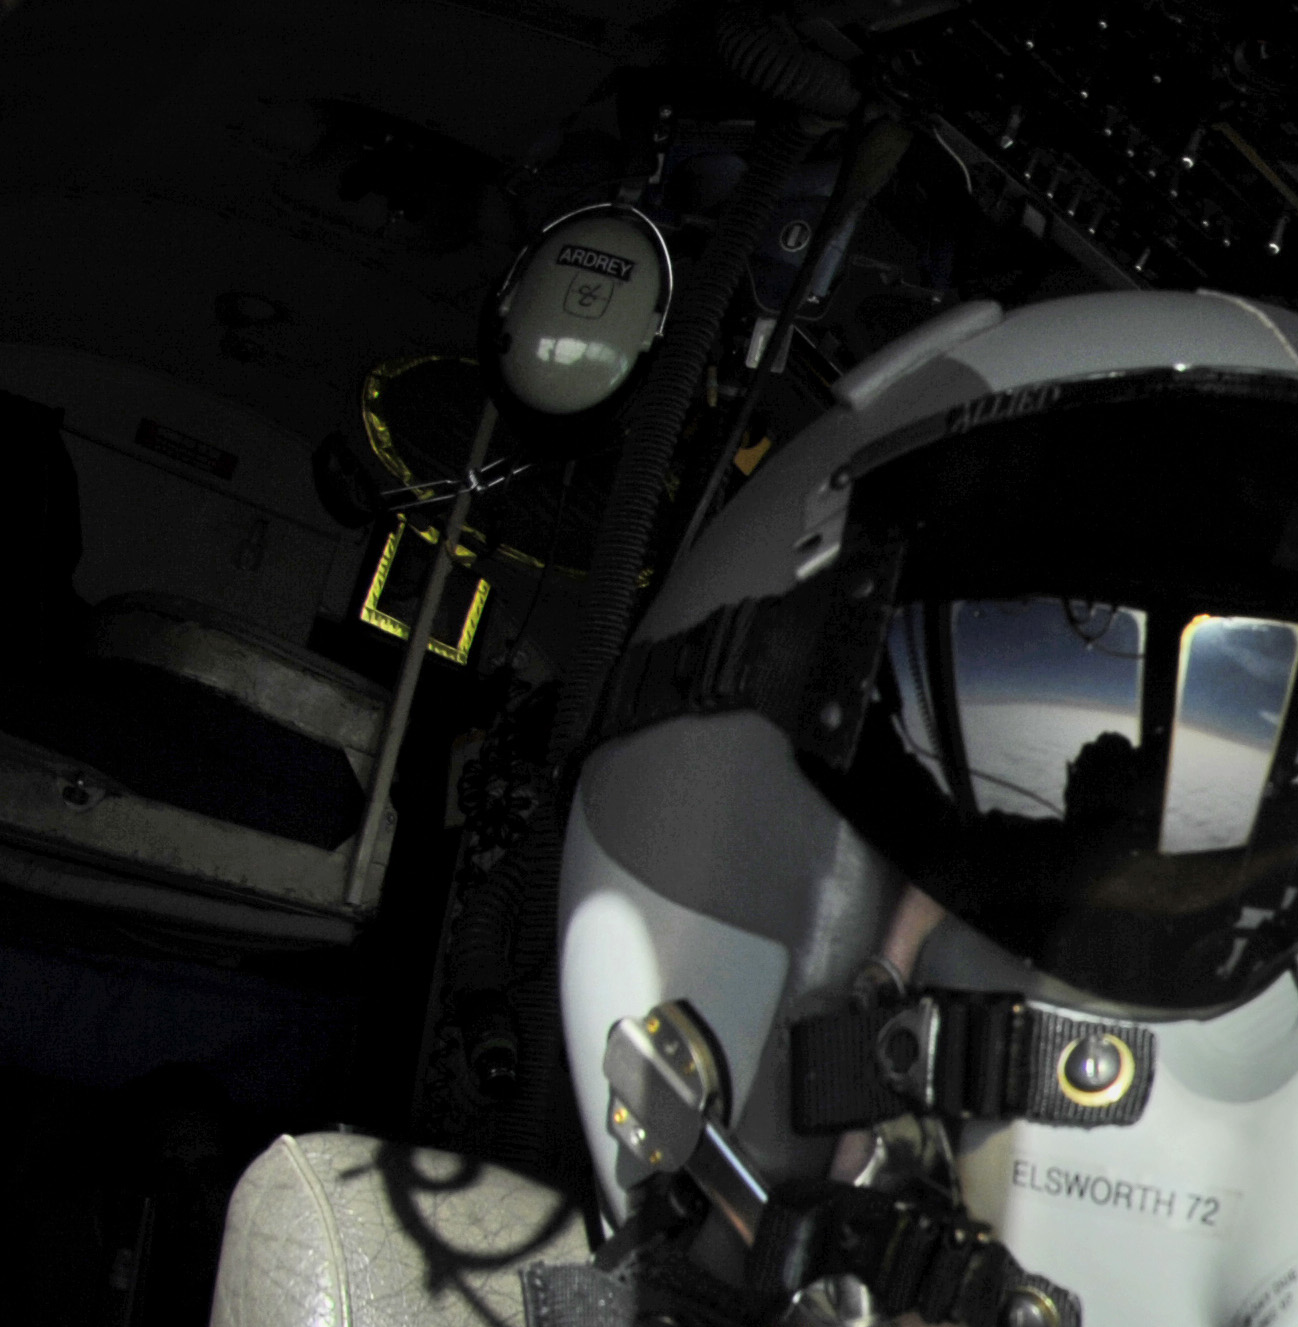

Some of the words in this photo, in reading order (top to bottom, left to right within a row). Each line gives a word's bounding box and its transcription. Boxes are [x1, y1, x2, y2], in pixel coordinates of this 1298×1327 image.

[558, 248, 632, 277] ARDREY
[1011, 1160, 1176, 1217] ELSWORTH
[1186, 1192, 1221, 1228] 72
